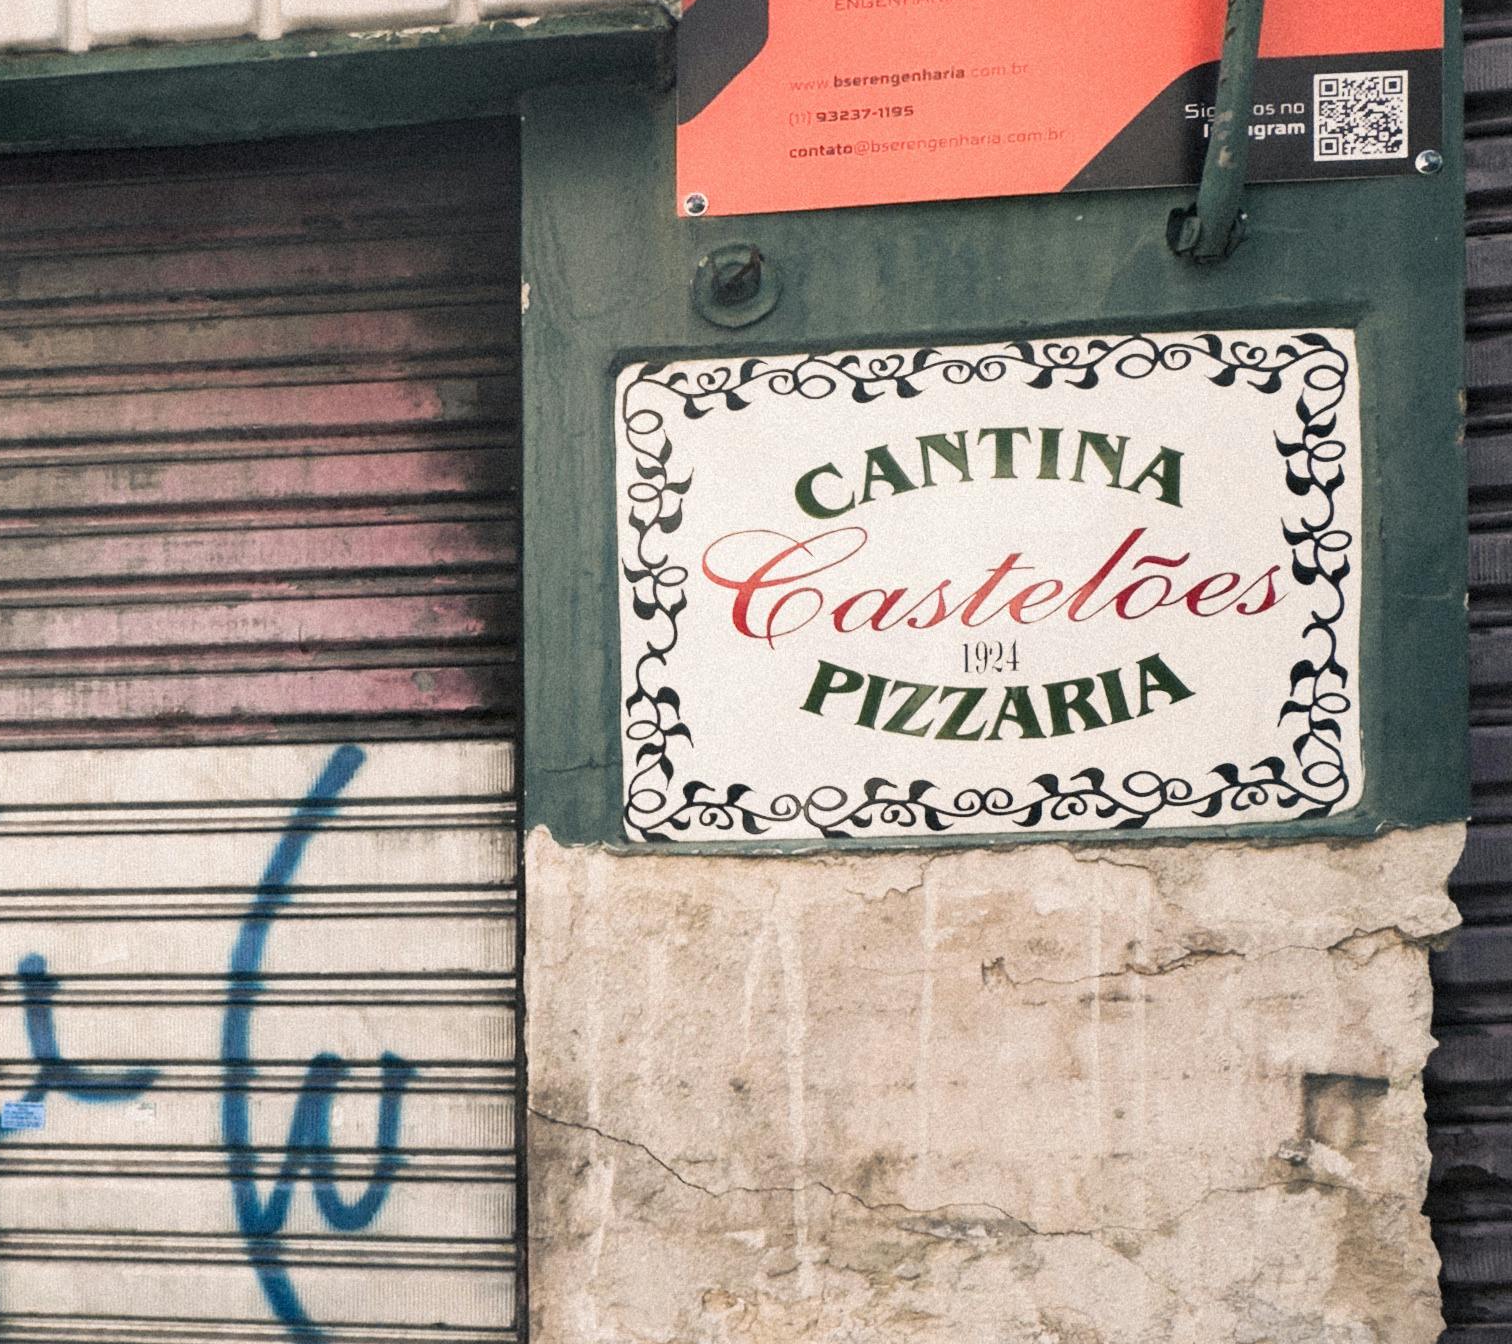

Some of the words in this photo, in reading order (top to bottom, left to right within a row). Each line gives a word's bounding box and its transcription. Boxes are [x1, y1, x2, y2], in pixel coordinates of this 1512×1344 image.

[815, 105, 915, 123] 93237-1195
[1280, 102, 1305, 115] no
[788, 127, 1067, 159] contato@bserengenharia.com.br
[1203, 122, 1306, 141] Igram
[793, 426, 1185, 520] CANTINA
[701, 526, 1291, 652] Castelões
[961, 639, 1020, 675] 1924
[799, 652, 1196, 743] PIZZARIA
